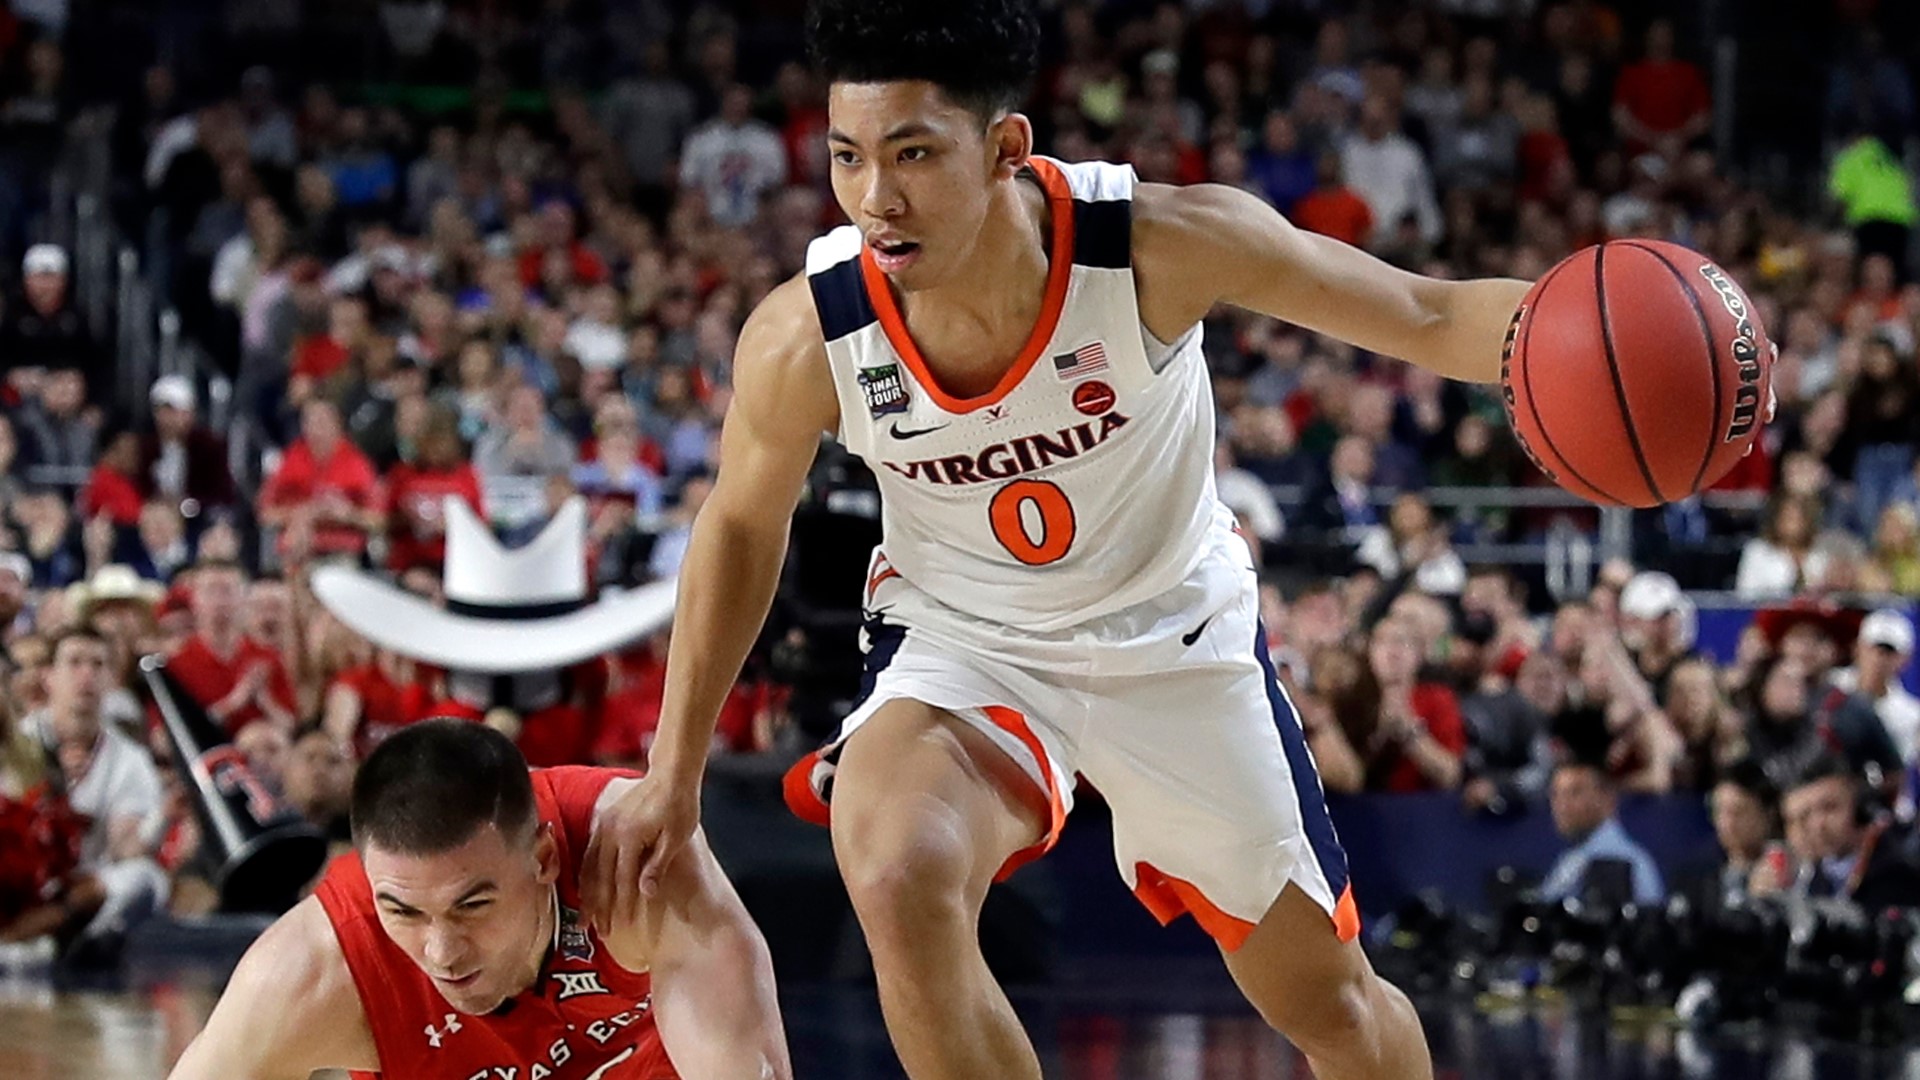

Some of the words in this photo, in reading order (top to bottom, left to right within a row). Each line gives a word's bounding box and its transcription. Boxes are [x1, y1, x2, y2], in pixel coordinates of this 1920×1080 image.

[864, 375, 899, 396] FINAL
[868, 386, 902, 407] FOUR
[881, 411, 1132, 485] VIRGINIA
[988, 478, 1076, 566] 0
[552, 972, 609, 999] XII
